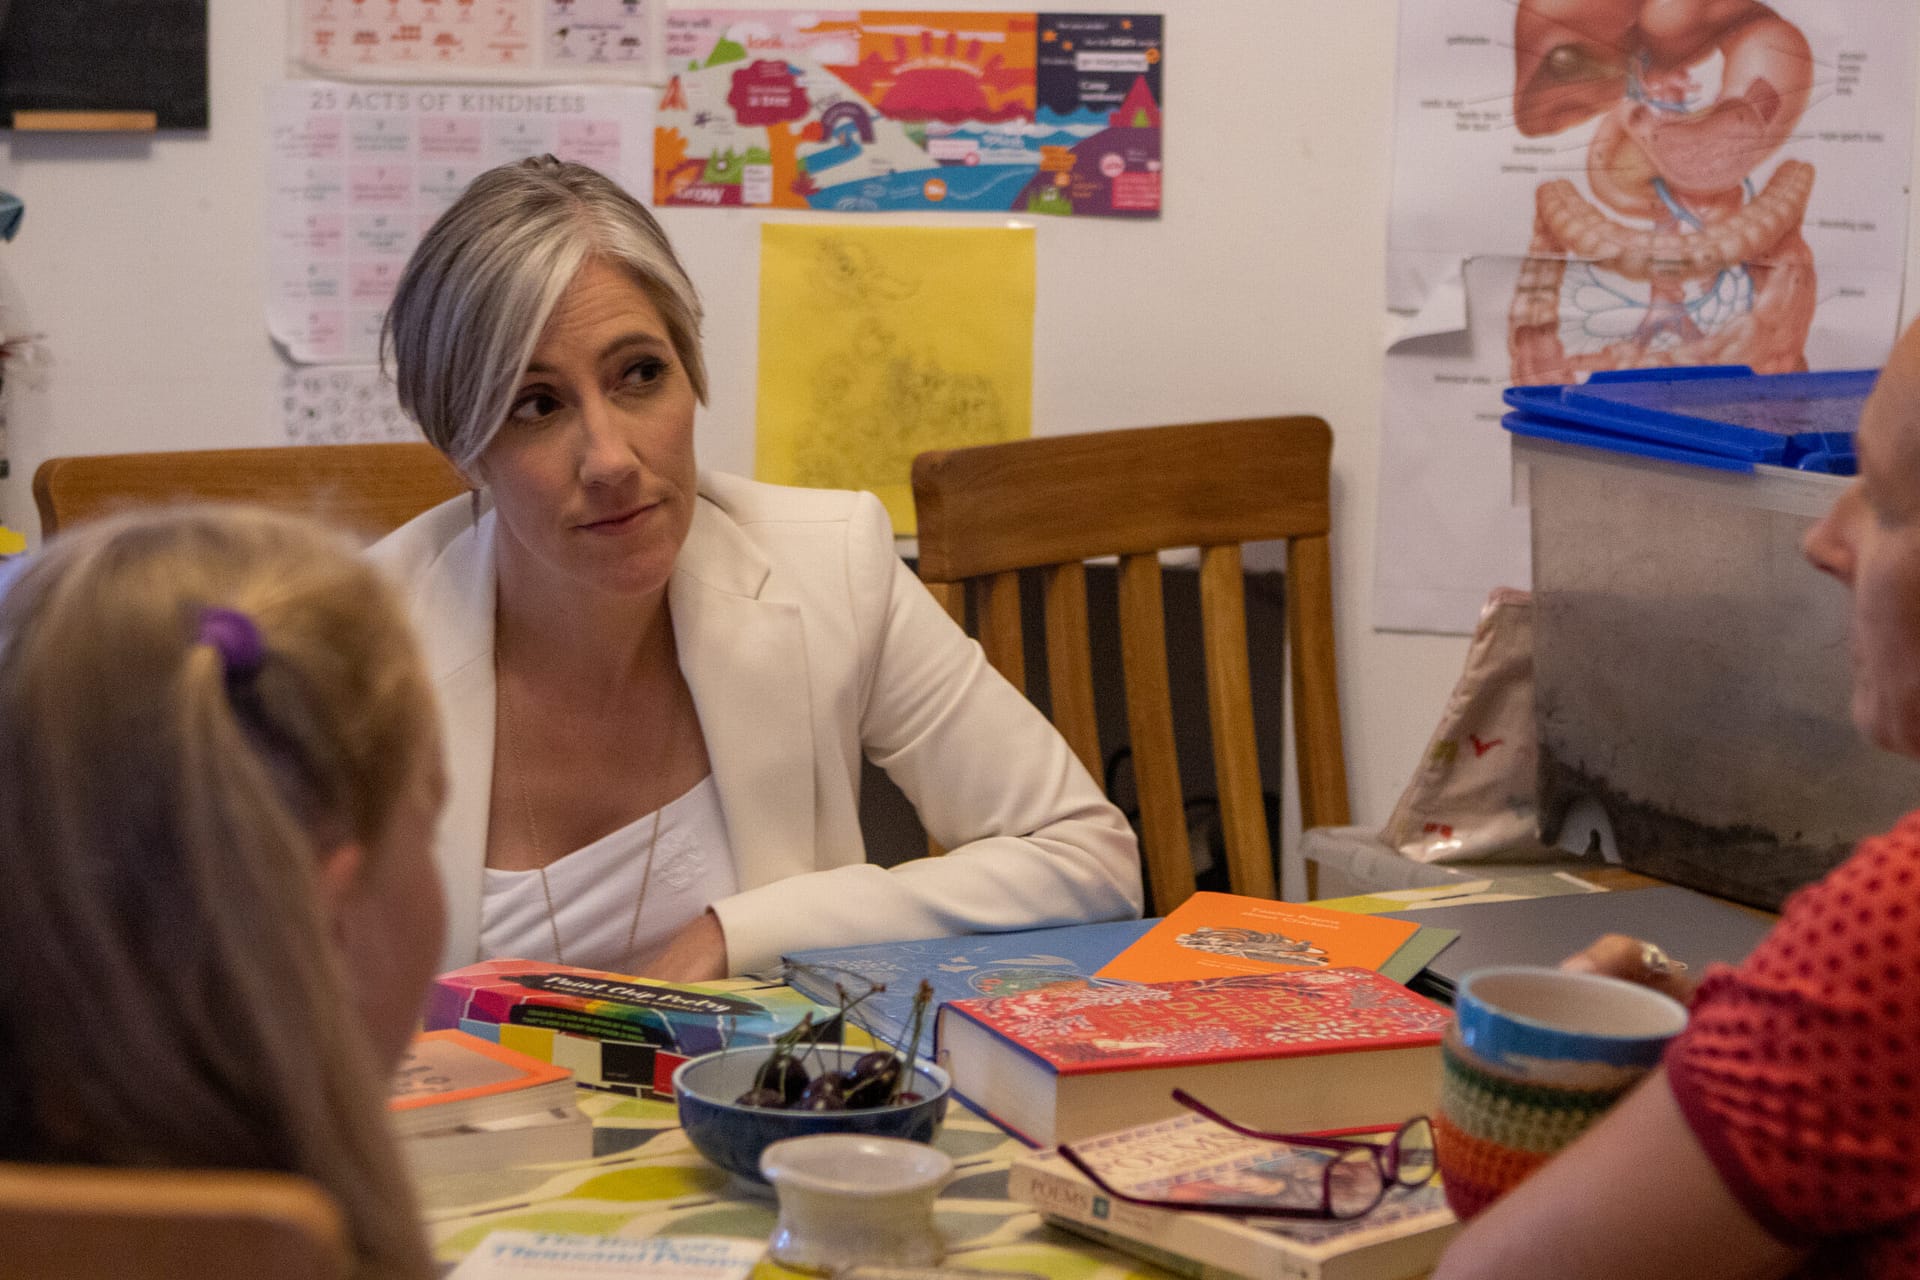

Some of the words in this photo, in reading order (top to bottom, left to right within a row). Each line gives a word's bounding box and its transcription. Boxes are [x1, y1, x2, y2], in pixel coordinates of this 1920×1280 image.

[310, 92, 337, 110] 25
[346, 92, 410, 111] ACTS
[418, 92, 450, 111] OF
[460, 92, 586, 114] KINDNESS
[544, 976, 609, 991] Paint
[607, 987, 657, 1000] Chip
[657, 994, 732, 1013] Poetry
[1193, 993, 1273, 1027] EVERY
[1254, 990, 1332, 1023] POEM
[1164, 1002, 1229, 1026] DAY
